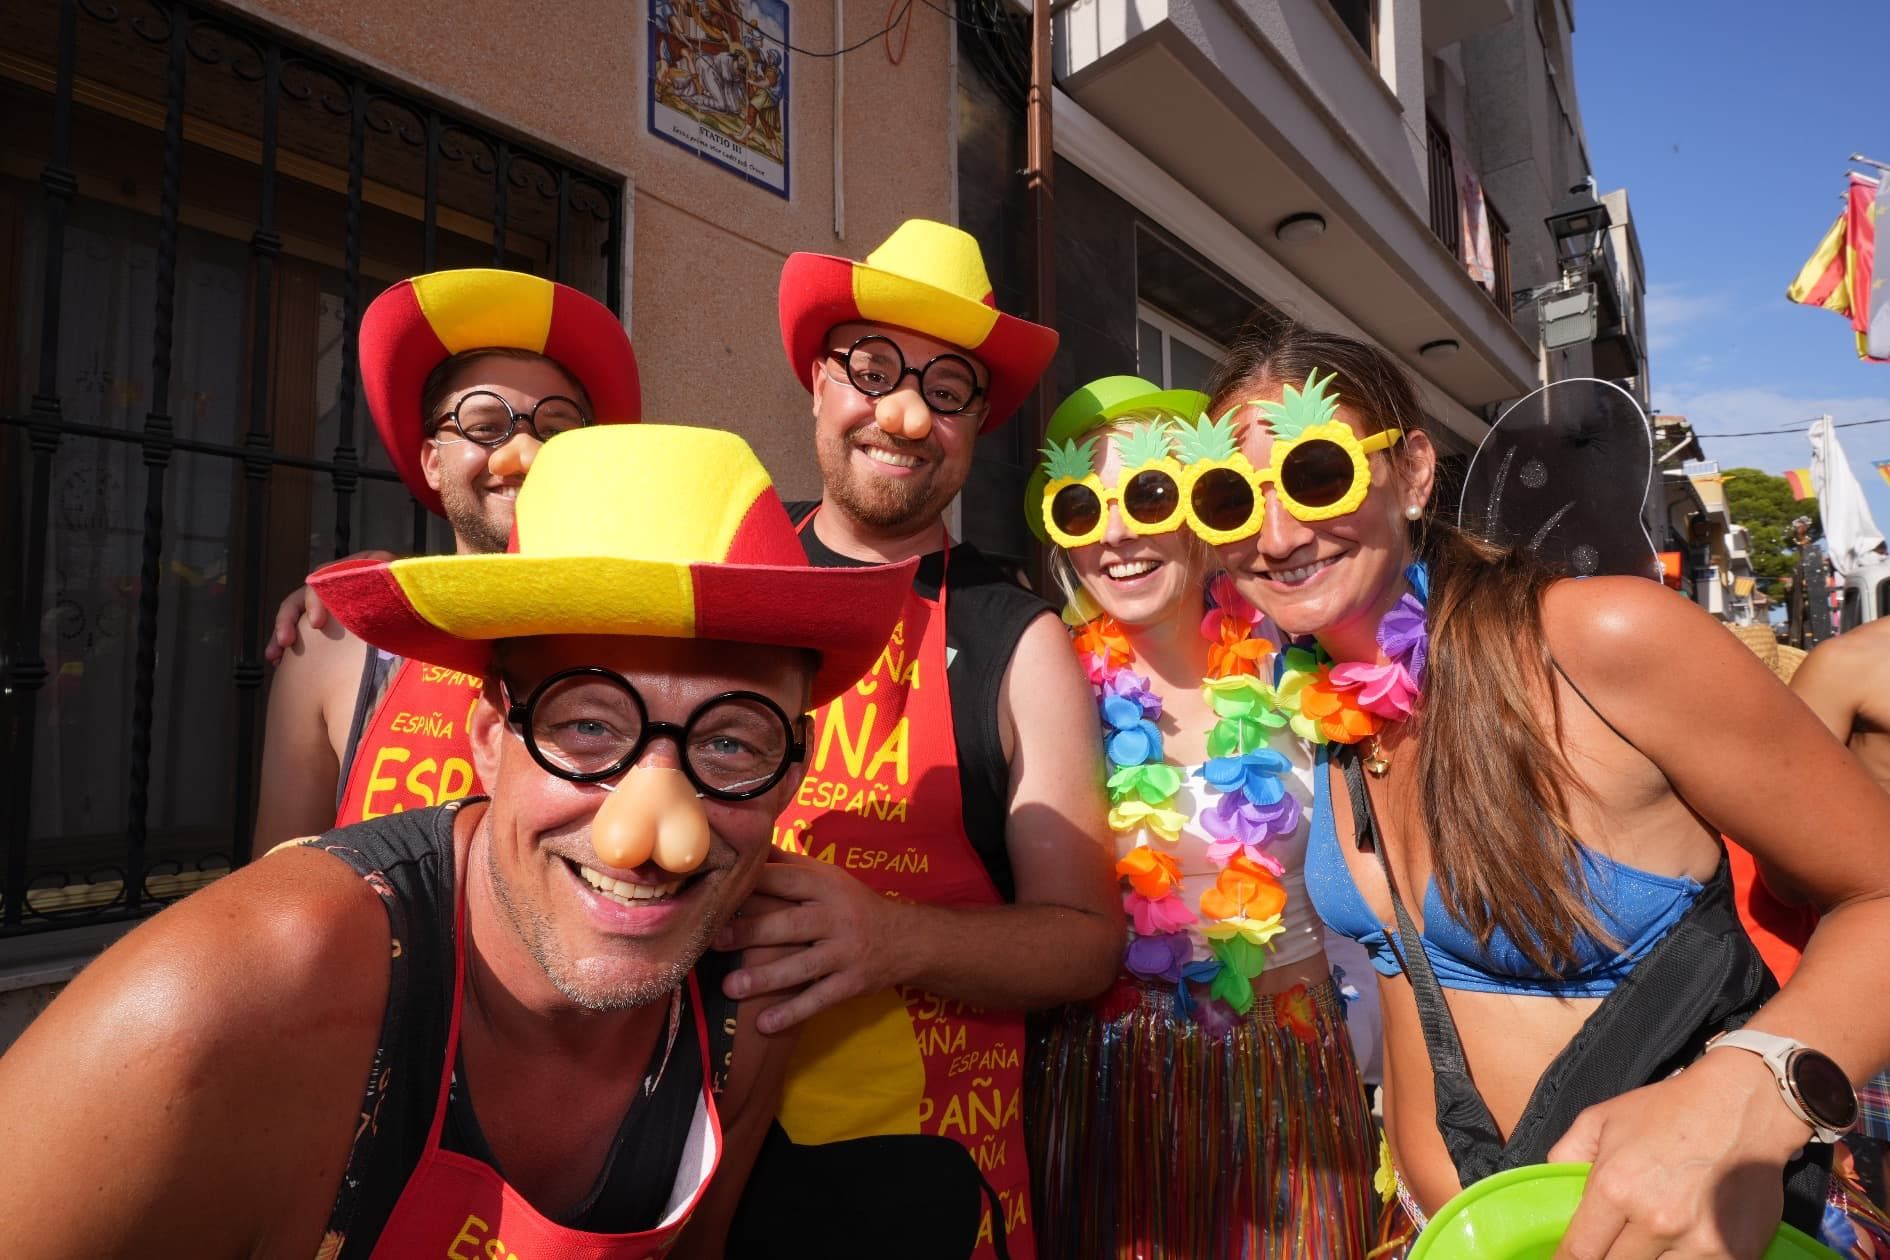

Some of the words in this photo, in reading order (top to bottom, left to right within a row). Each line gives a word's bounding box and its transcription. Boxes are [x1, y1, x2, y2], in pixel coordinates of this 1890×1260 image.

[699, 126, 730, 148] STATIO
[732, 143, 742, 155] III
[391, 712, 453, 739] ESPAÑA
[797, 776, 908, 823] ESPAÑA
[845, 847, 929, 873] ESPAÑA
[948, 1042, 1019, 1077] ESPAÑA
